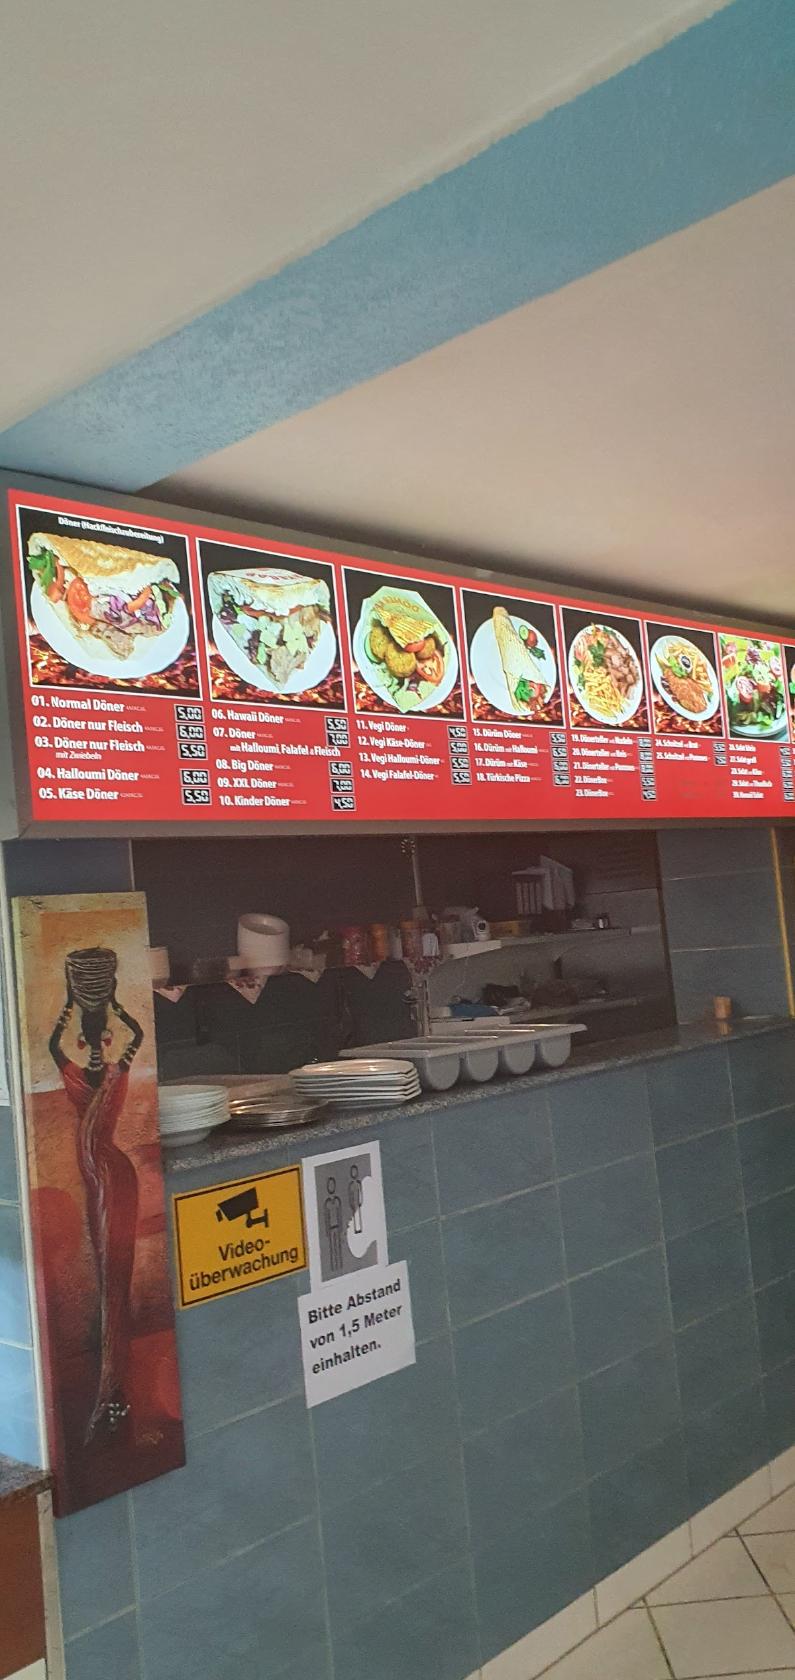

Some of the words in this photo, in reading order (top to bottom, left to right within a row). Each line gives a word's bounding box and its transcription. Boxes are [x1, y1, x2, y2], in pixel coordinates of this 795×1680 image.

[58, 517, 81, 527] Döner
[31, 695, 49, 707] 01.
[51, 696, 91, 710] Normal
[93, 698, 124, 712] Döner
[178, 707, 201, 720] 5,00
[212, 709, 226, 720] 06.
[227, 710, 257, 722] Hawaii
[259, 712, 284, 724] Döner
[33, 716, 51, 728] 02.
[53, 717, 86, 730] Döner
[88, 720, 106, 731] nur
[108, 720, 143, 733] Fleisch
[328, 718, 346, 730] 5,50
[356, 720, 368, 729] 11.
[368, 721, 384, 732] Vegi
[385, 722, 406, 732] Döner
[179, 726, 203, 739] 6,00
[213, 727, 228, 738] 07.
[229, 728, 256, 739] Döner
[473, 728, 482, 736] 15.
[483, 729, 503, 738] Dürüm
[504, 730, 521, 739] Döner
[34, 736, 53, 748] 03.
[54, 737, 88, 750] Döner
[90, 740, 108, 750] nur
[110, 740, 145, 752] Fleisch
[358, 736, 369, 745] 12.
[370, 737, 386, 748] Vegi
[474, 743, 484, 752] 16.
[484, 743, 504, 752] Dürüm
[182, 745, 205, 758] 5,50
[282, 745, 309, 755] Falafel
[315, 746, 340, 757] Fleisch
[359, 753, 371, 762] 13.
[371, 754, 387, 764] Vegi
[216, 759, 230, 769] 08.
[232, 759, 247, 772] Big
[248, 760, 274, 771] Döner
[331, 764, 350, 775] 6,00
[37, 767, 55, 778] 04.
[57, 768, 106, 780] Halloumi
[107, 768, 139, 781] Döner
[183, 771, 207, 784] 6,00
[361, 769, 372, 778] 14.
[372, 770, 388, 781] Vegi
[390, 770, 434, 780] Falafel-Döner
[486, 773, 514, 782] Türkische
[218, 778, 232, 787] 09.
[233, 778, 249, 788] XXL
[251, 778, 277, 788] Döner
[39, 788, 57, 799] 05.
[59, 787, 85, 799] Käse
[86, 788, 119, 800] Döner
[186, 790, 209, 803] 5,50
[219, 795, 233, 805] 10.
[235, 796, 263, 806] Kinder
[265, 796, 290, 806] Döner
[334, 797, 354, 809] 4,50
[218, 1238, 271, 1262] Video-
[189, 1246, 298, 1291] überwachung
[308, 1303, 343, 1324] Bitte
[346, 1279, 401, 1307] Abstand
[309, 1331, 335, 1350] von
[339, 1318, 360, 1339] 1,5
[364, 1304, 403, 1328] Meter
[312, 1341, 382, 1374] einhalten.
